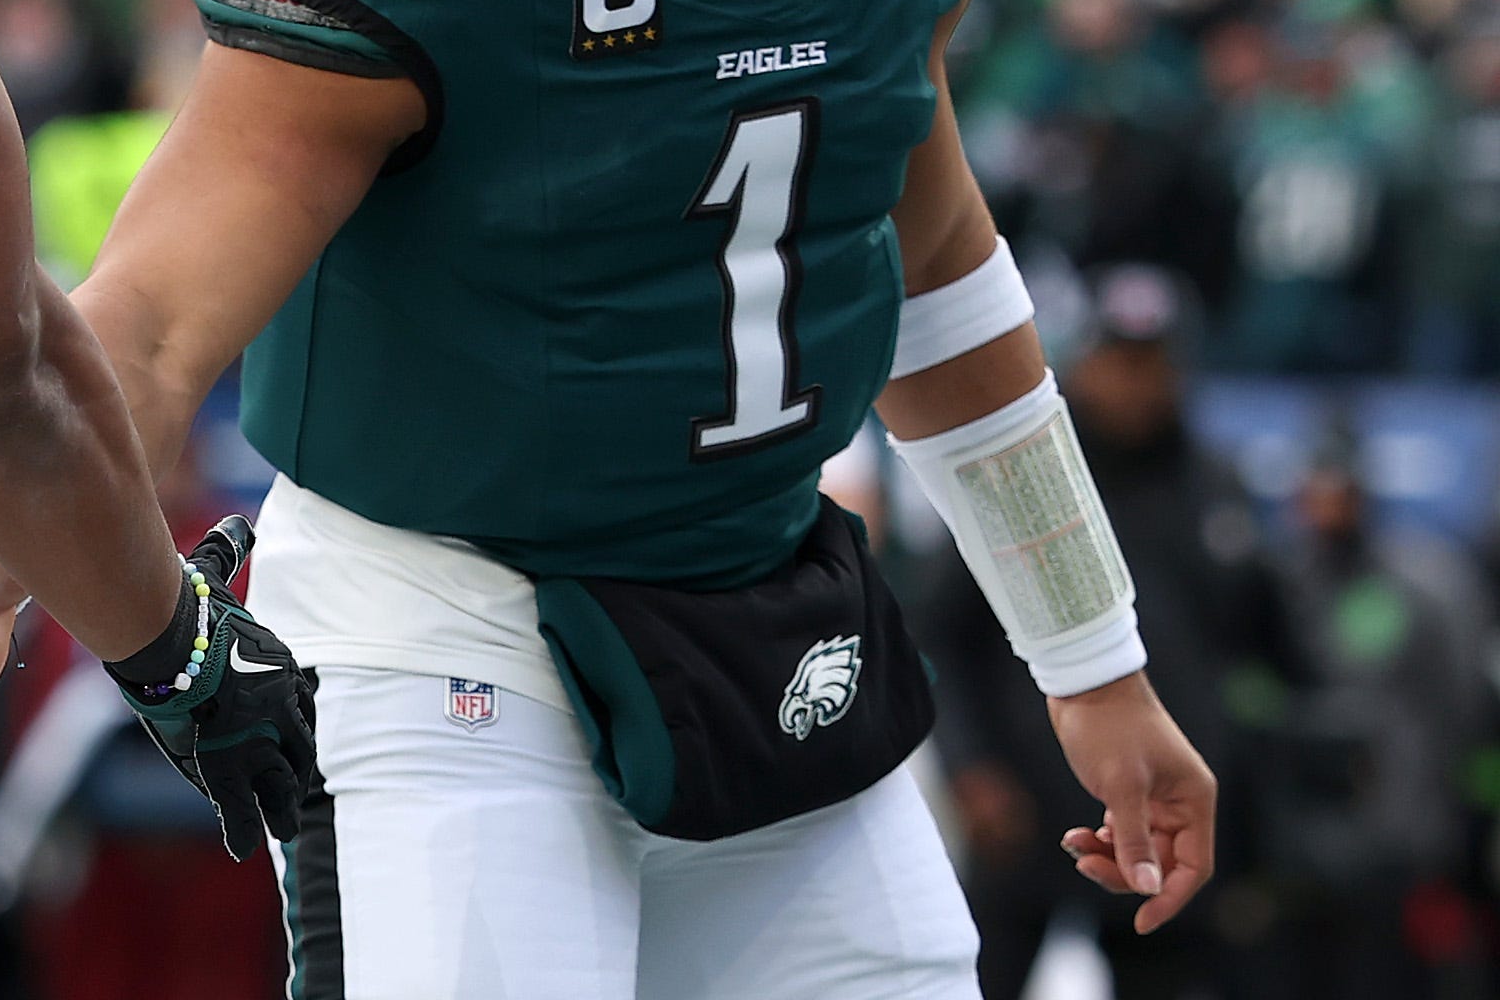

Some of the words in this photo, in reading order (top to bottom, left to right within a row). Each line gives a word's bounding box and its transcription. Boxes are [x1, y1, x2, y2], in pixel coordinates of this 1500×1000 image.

[715, 40, 828, 81] EAGLES
[682, 95, 823, 464] 1
[455, 694, 492, 719] NFL
